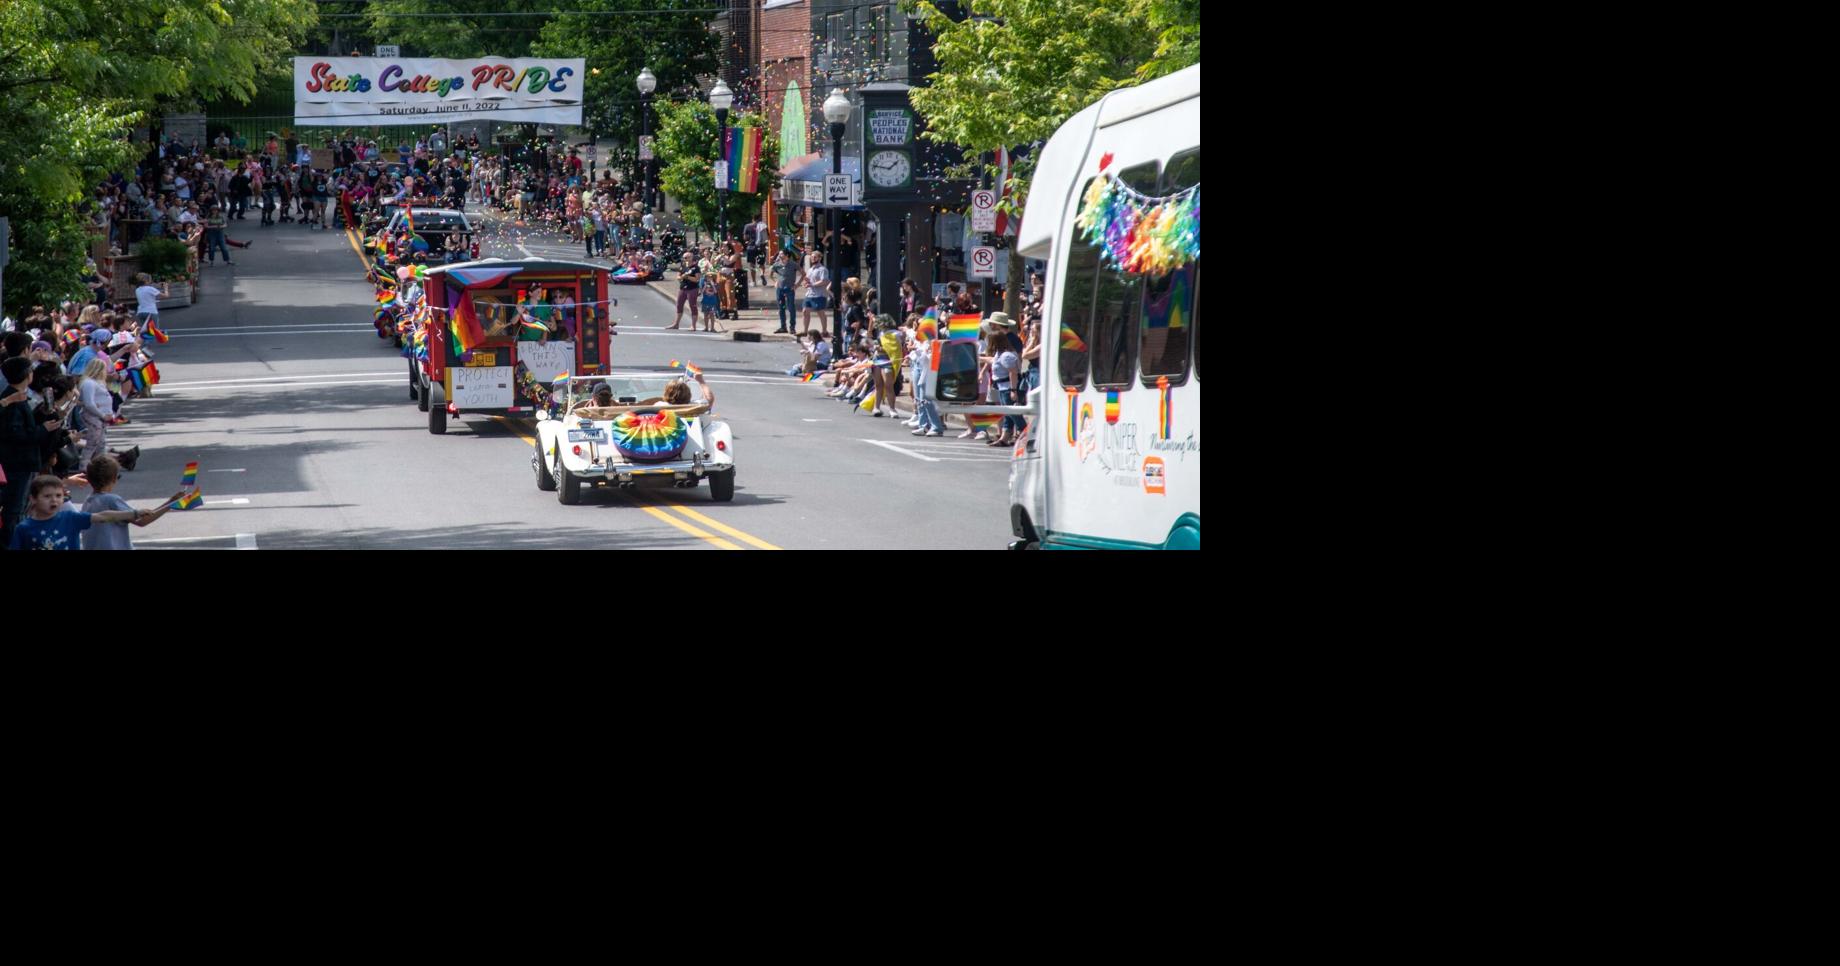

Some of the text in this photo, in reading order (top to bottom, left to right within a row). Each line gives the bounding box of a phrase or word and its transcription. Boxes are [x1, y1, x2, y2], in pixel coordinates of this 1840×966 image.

[306, 62, 574, 97] State College PRIDE
[380, 106, 431, 116] Saturday,
[436, 104, 459, 113] June
[475, 102, 501, 110] 2022
[872, 119, 907, 127] PEOPLES
[873, 127, 905, 135] NATIONAL
[876, 135, 904, 143] BANK
[829, 177, 847, 185] ONE
[528, 342, 557, 352] BORN
[533, 352, 558, 361] THIS
[458, 368, 509, 383] PROTECT
[464, 394, 498, 405] YOUTH
